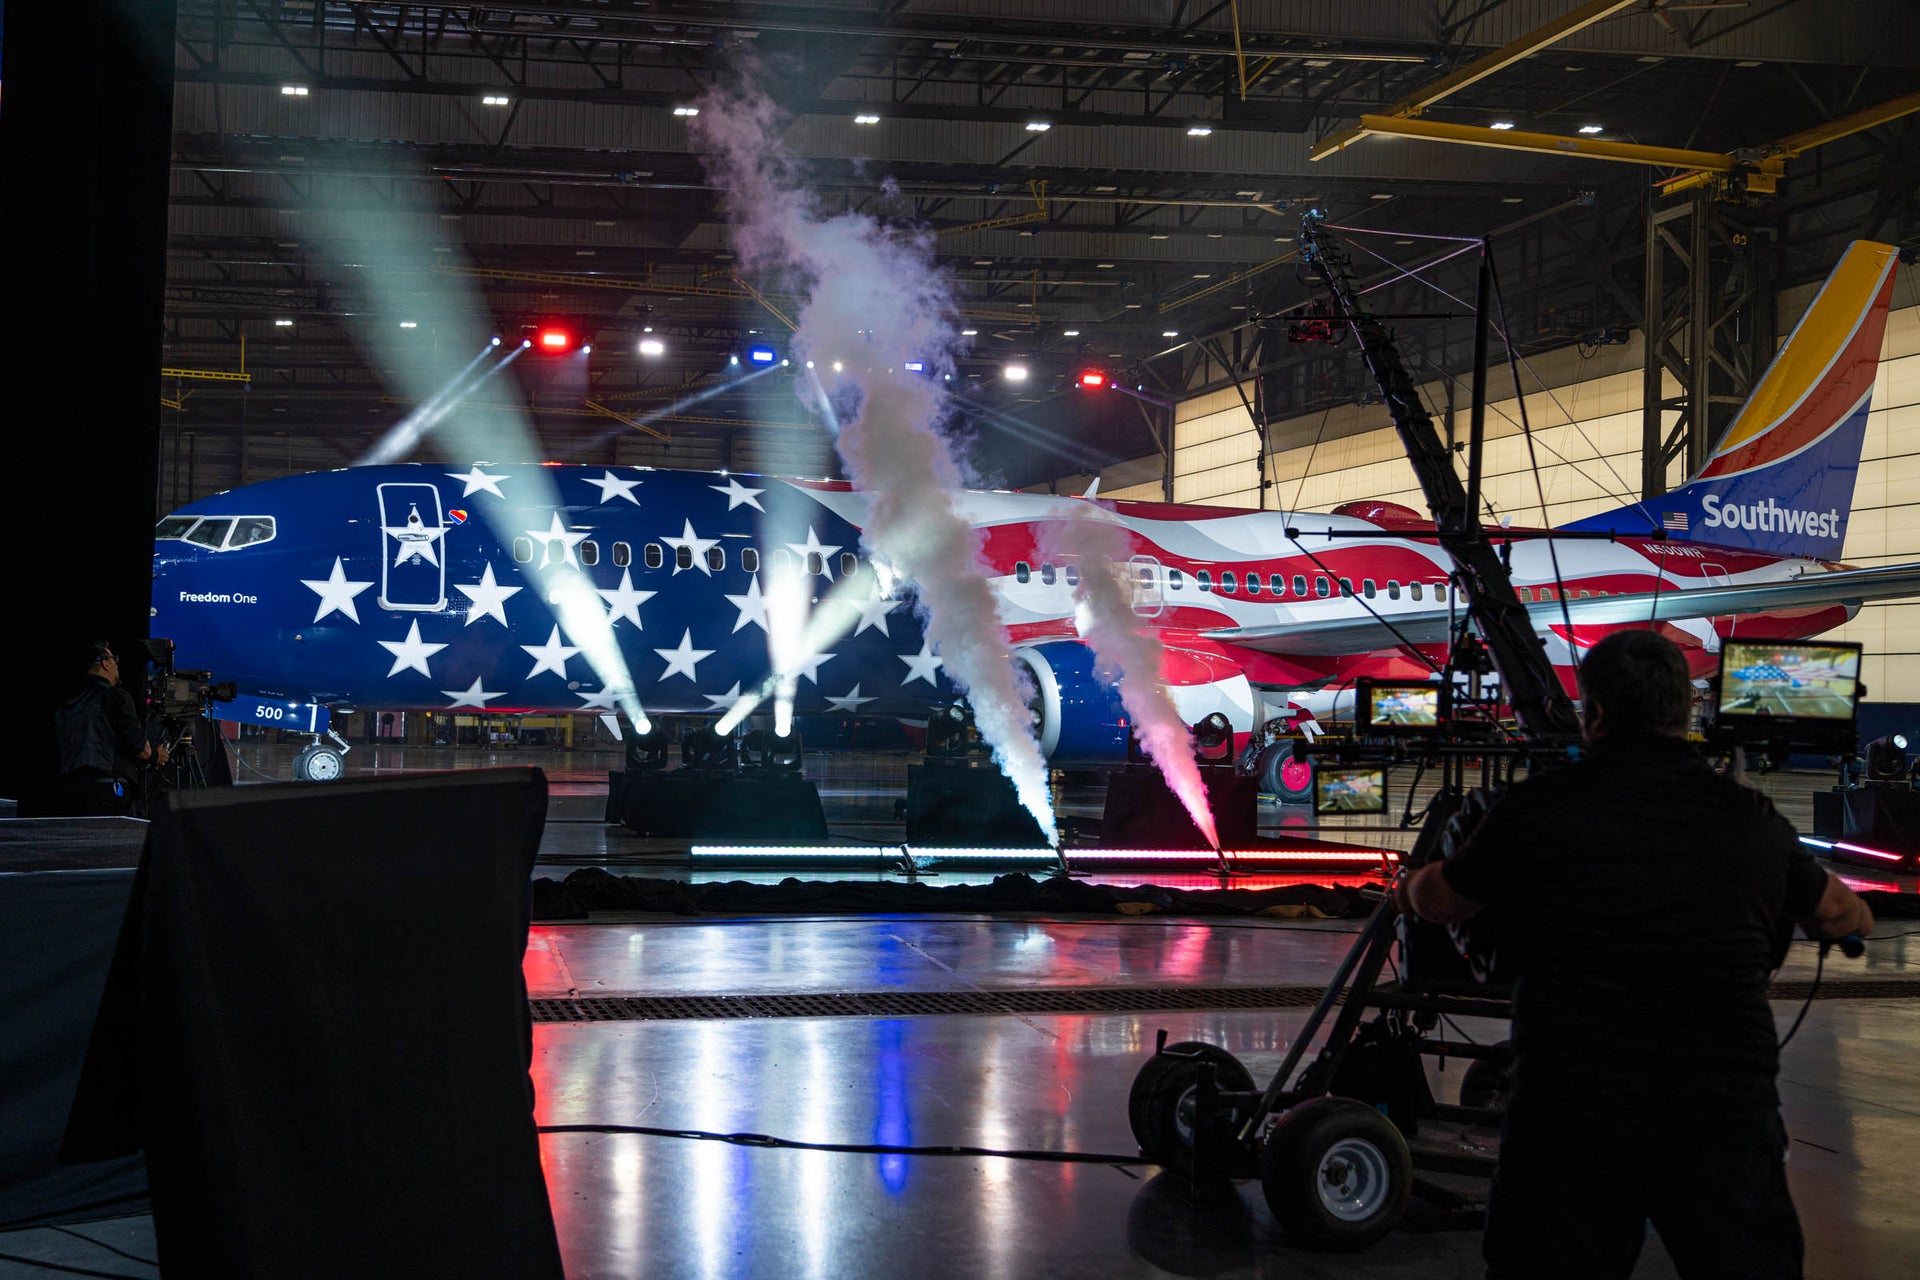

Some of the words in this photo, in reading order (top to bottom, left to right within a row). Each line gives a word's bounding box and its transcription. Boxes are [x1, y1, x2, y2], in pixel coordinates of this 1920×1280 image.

[1702, 494, 1840, 539] Southwest
[179, 591, 231, 603] Freedom
[233, 592, 258, 604] One
[255, 704, 283, 720] 500
